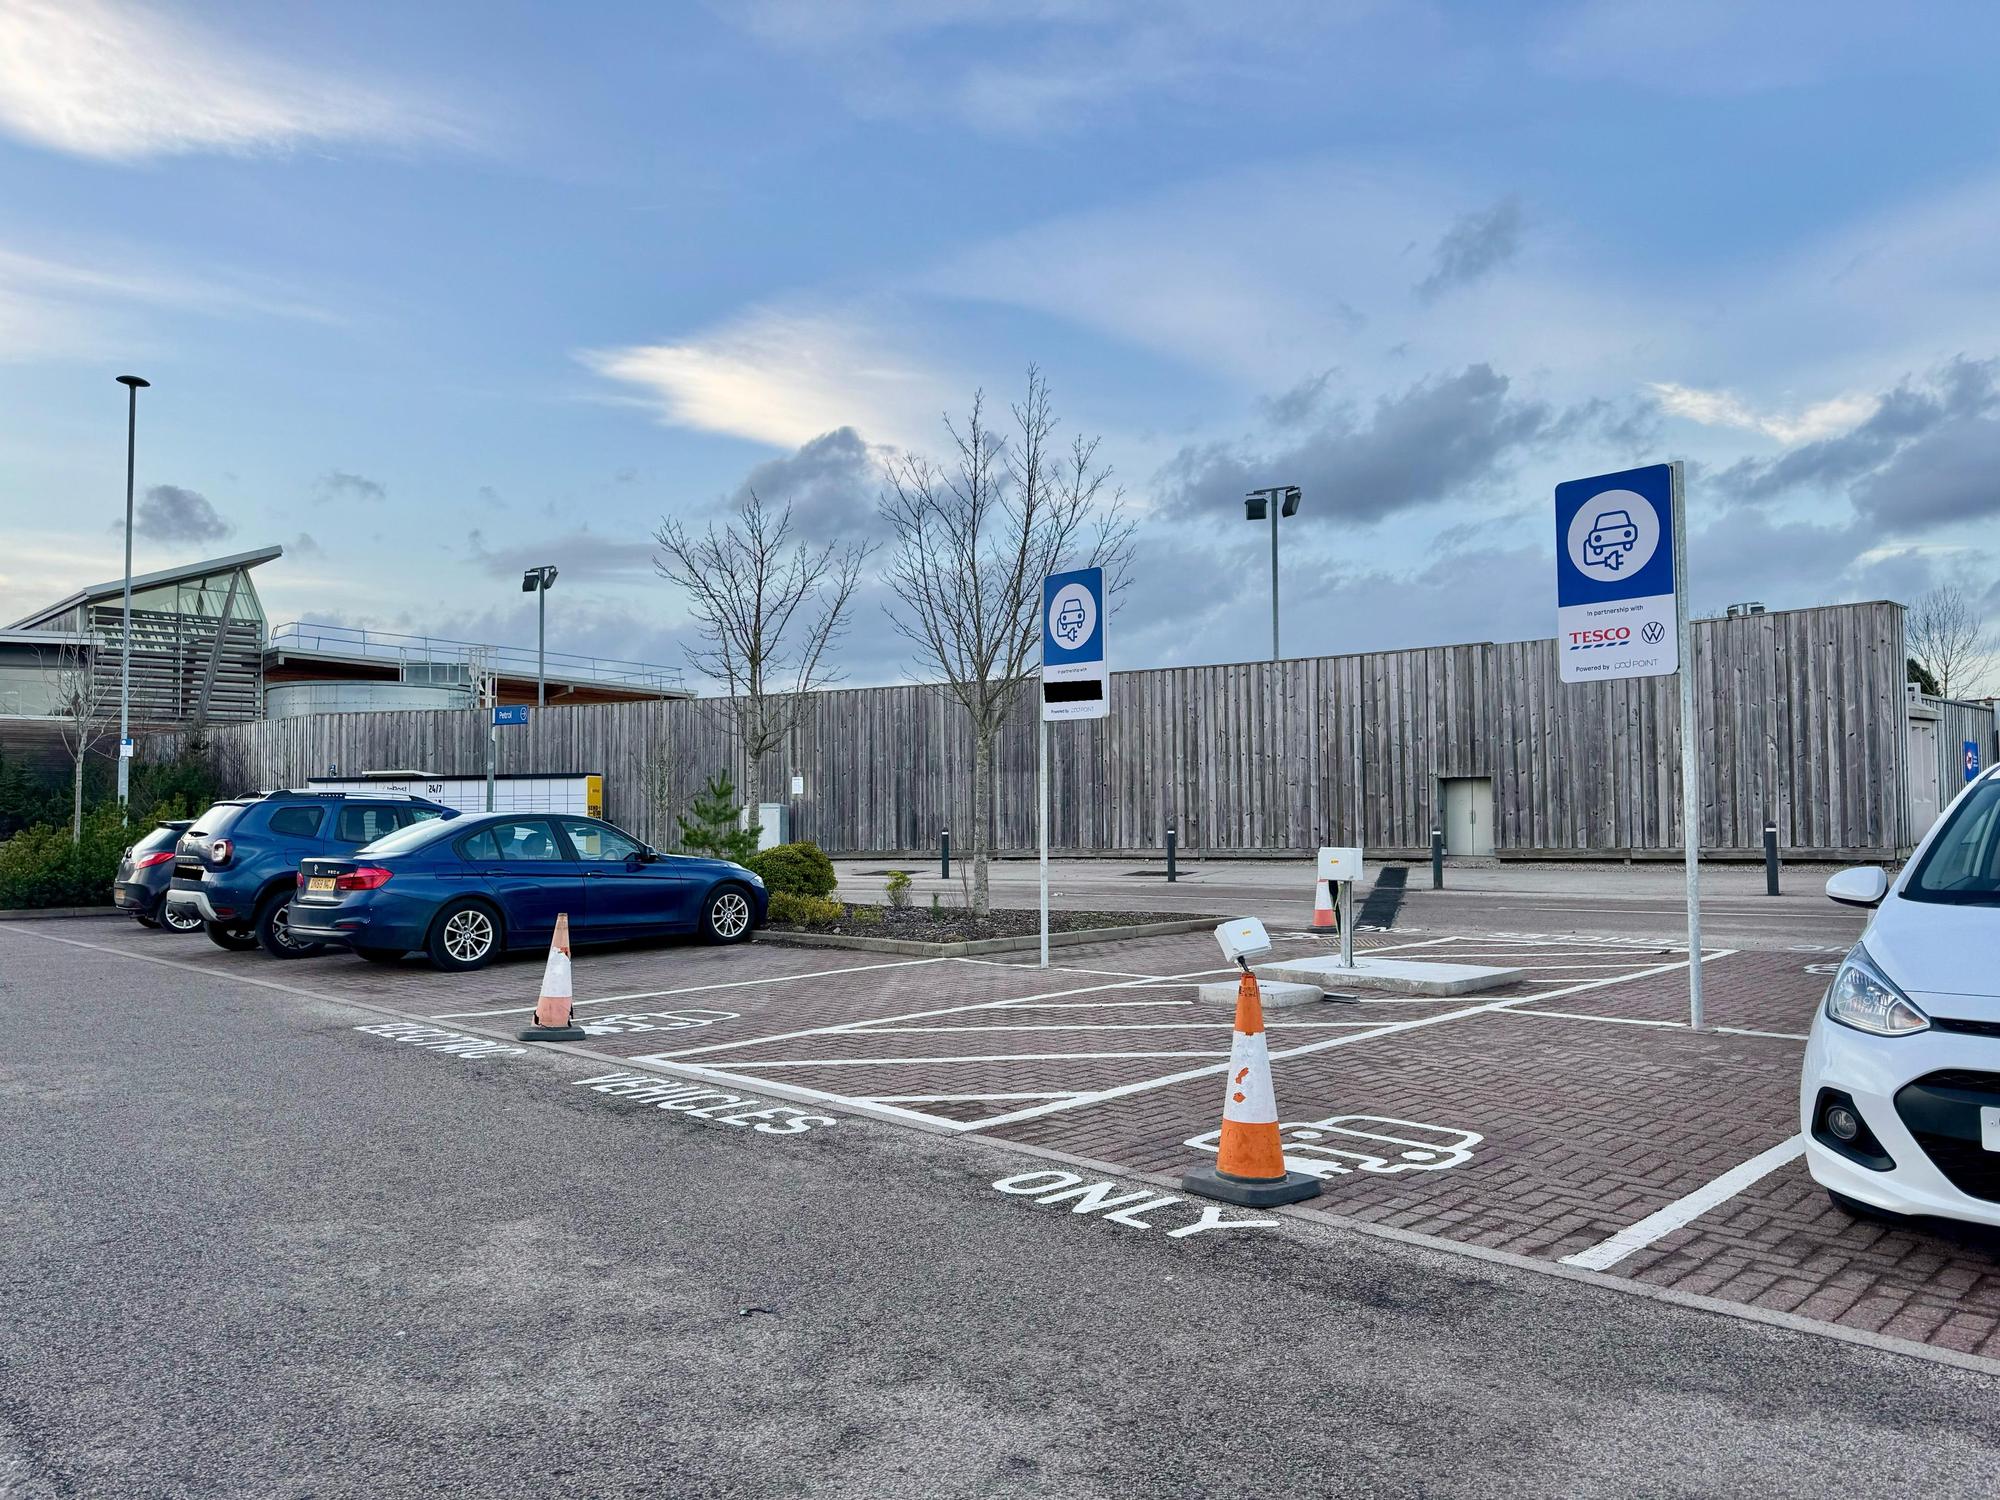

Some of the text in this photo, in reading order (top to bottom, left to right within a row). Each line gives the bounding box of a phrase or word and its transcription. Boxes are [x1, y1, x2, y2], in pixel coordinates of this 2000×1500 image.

[1593, 606, 1630, 617] partnership
[1569, 626, 1631, 644] TESCO
[1576, 664, 1601, 672] Powered
[499, 711, 513, 720] Petrol
[428, 784, 442, 793] 24/7
[353, 1021, 528, 1059] ELECTRIC
[571, 1071, 837, 1135] VEHICLES
[992, 1170, 1281, 1238] ONLY
